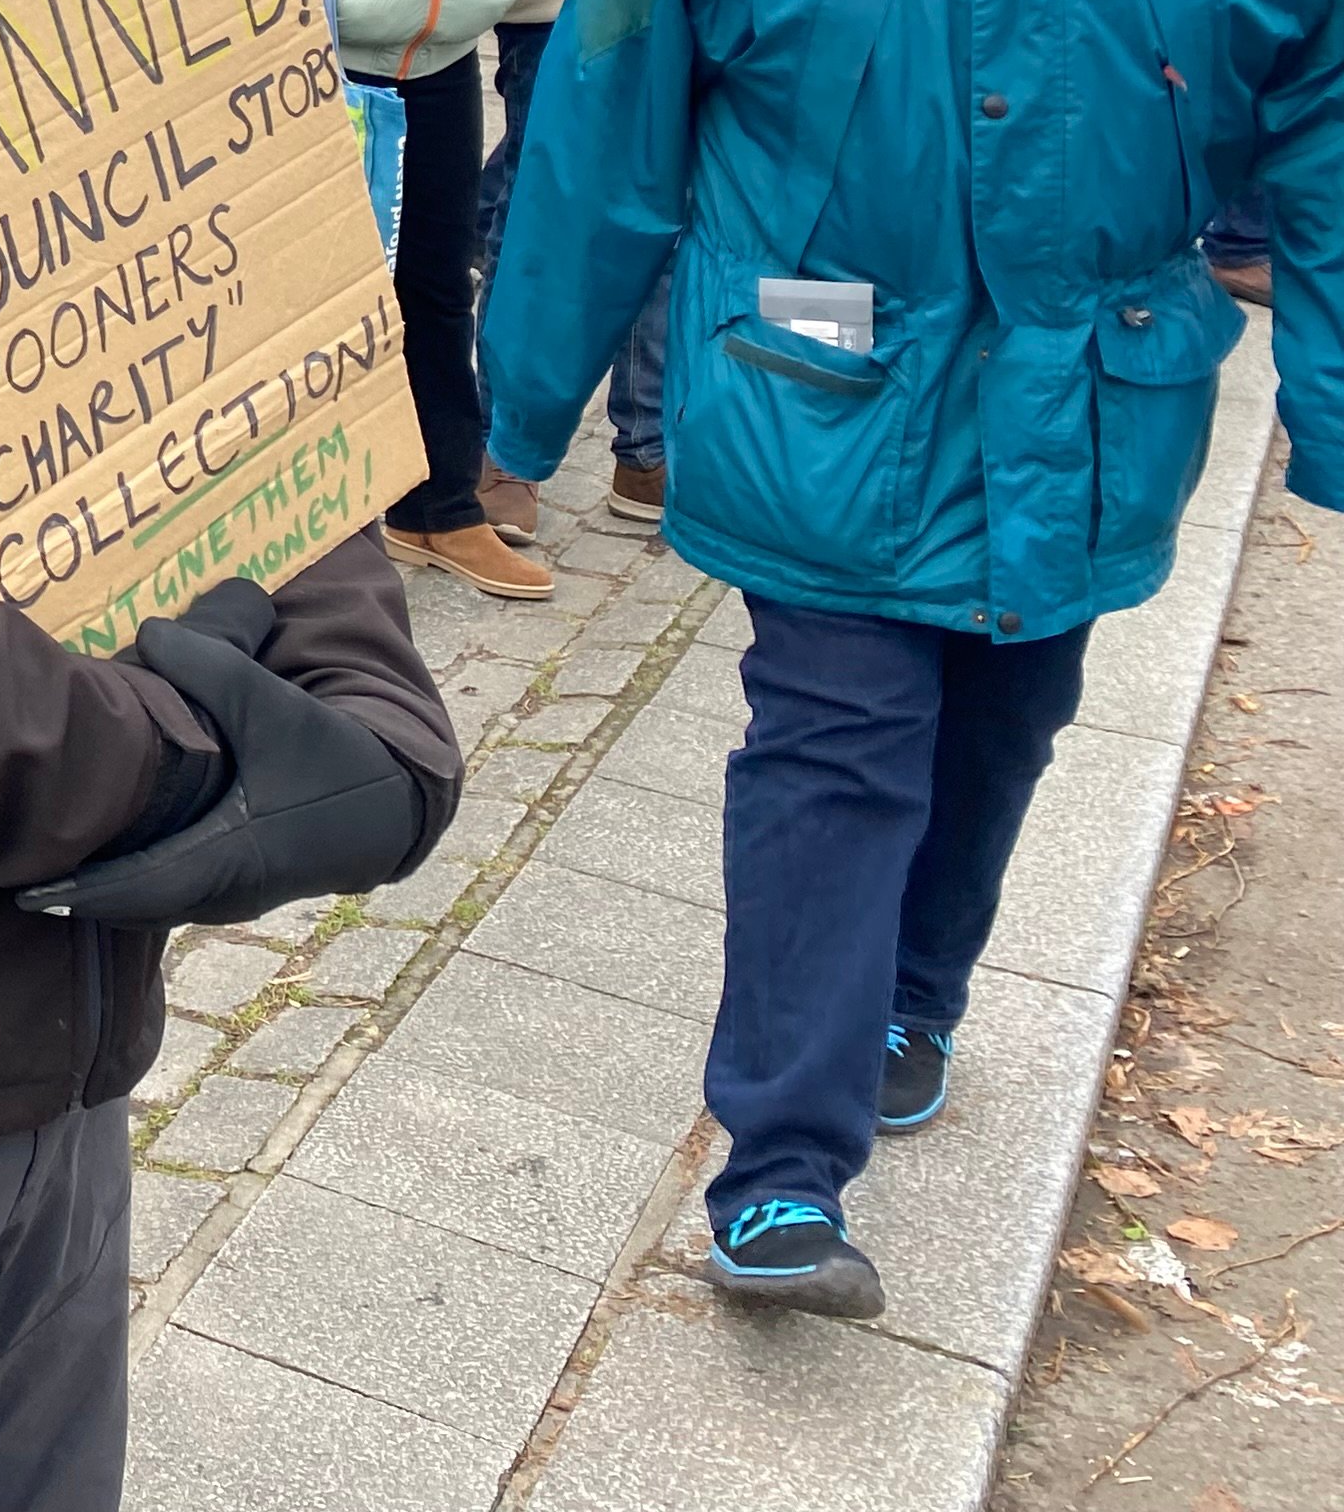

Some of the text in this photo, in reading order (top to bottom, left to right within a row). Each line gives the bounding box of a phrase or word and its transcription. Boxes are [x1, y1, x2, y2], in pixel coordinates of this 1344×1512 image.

[228, 42, 340, 155] STOPS
[386, 206, 402, 280] proje
[232, 420, 350, 534] THEM
